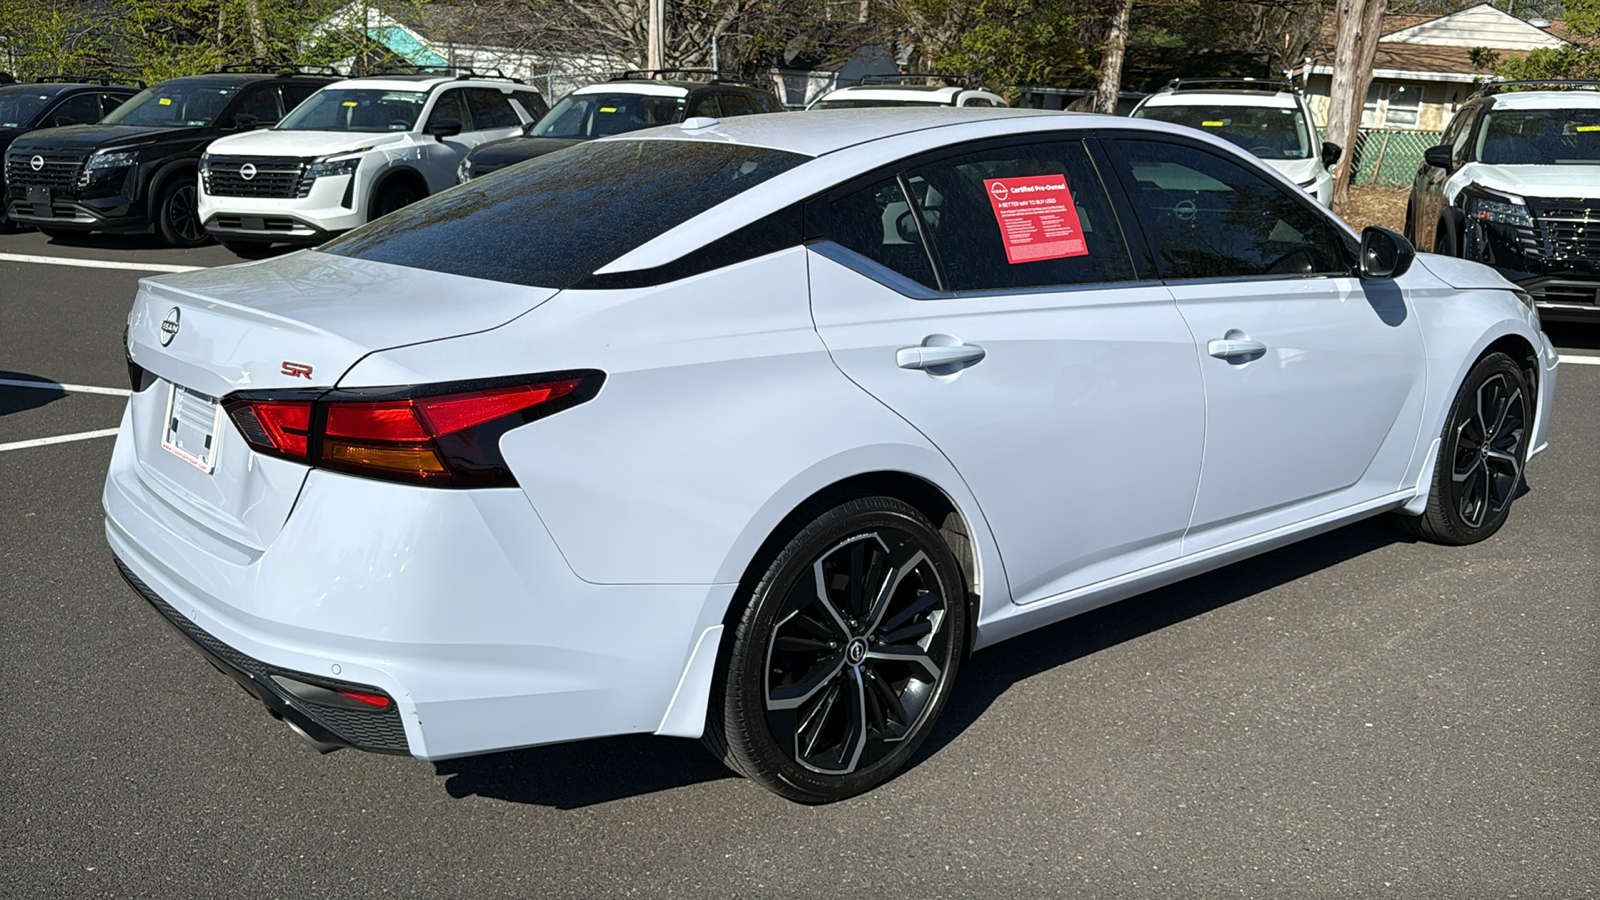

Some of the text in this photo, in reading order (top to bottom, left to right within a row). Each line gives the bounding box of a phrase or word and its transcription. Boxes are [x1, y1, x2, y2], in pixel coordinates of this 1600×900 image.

[1010, 184, 1065, 194] Certified Pre-Owned
[281, 361, 313, 380] SR
